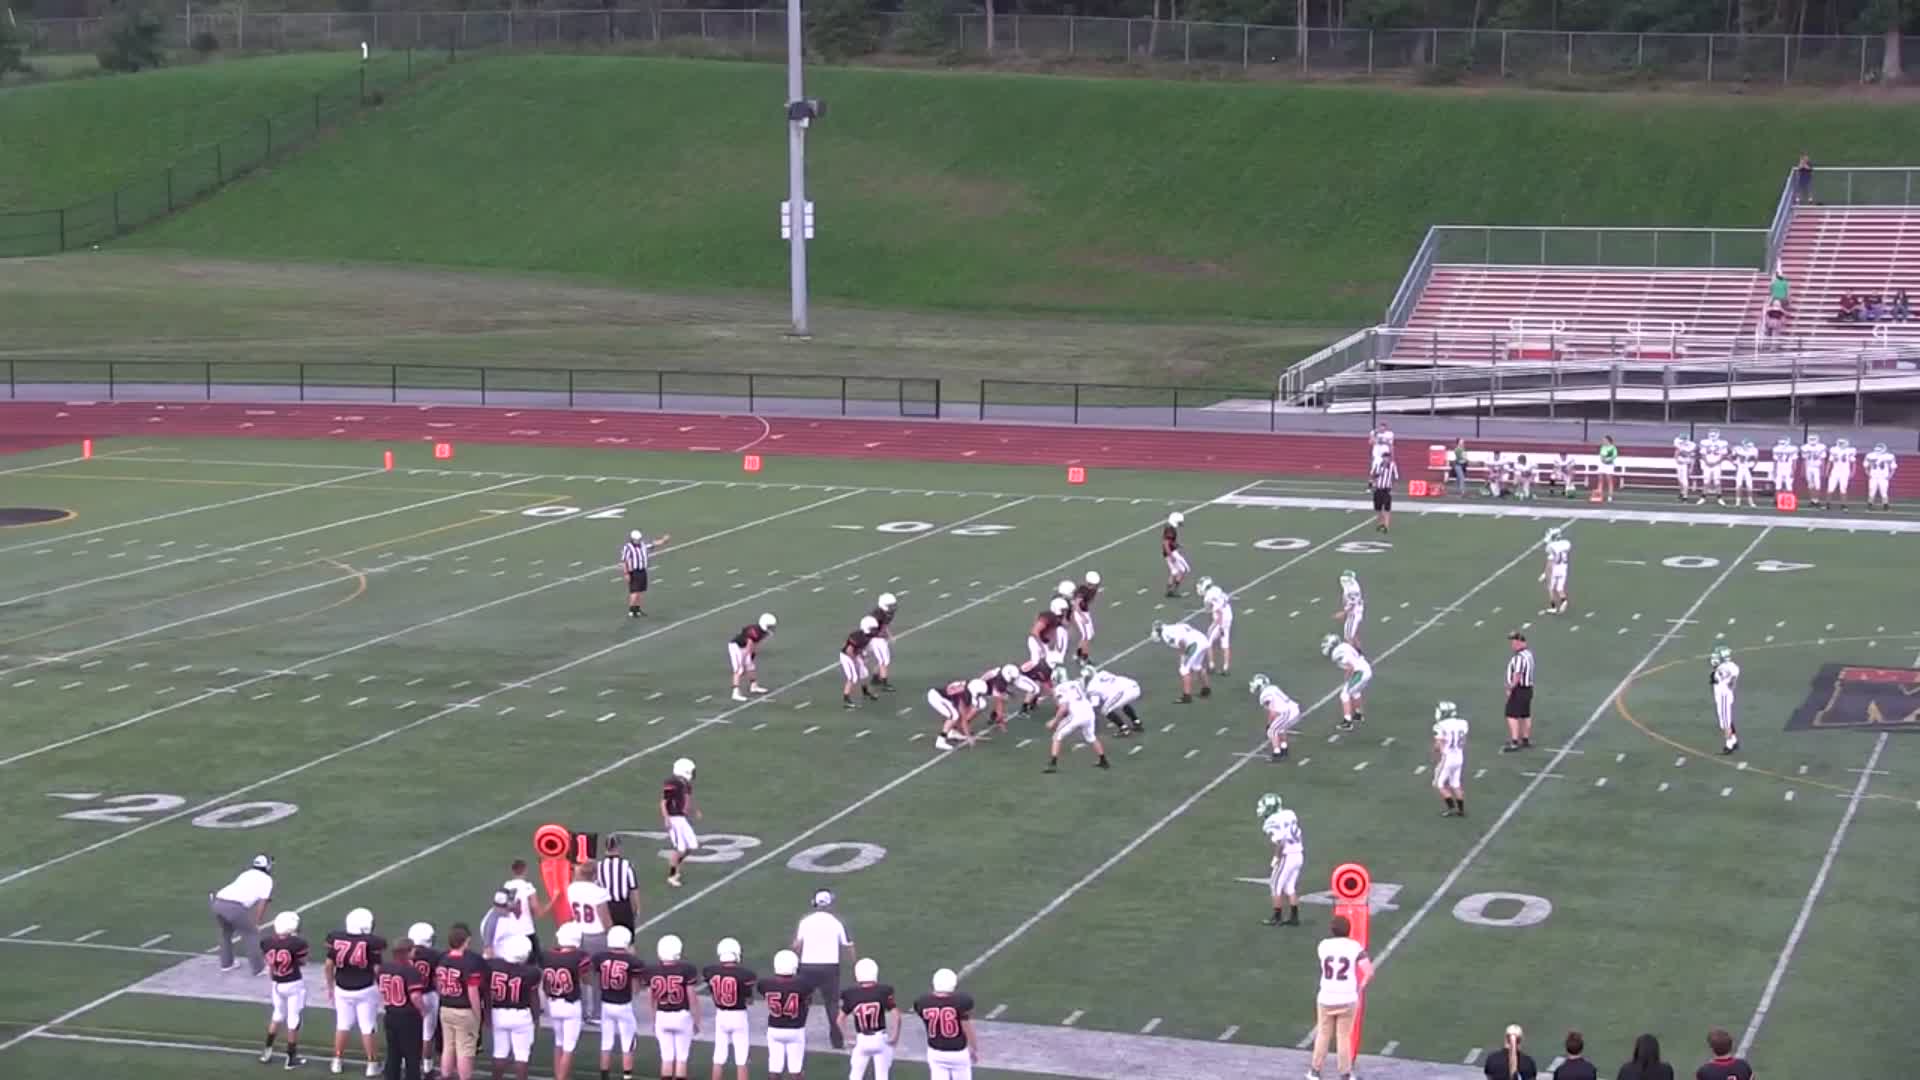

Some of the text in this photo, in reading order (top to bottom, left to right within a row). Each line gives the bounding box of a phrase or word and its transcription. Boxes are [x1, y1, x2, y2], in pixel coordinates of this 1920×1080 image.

[56, 793, 299, 829] 20
[576, 834, 589, 863] 1
[333, 939, 369, 969] 74
[1323, 956, 1351, 981] 62
[491, 971, 523, 1004] 51
[599, 958, 630, 991] 15
[649, 974, 684, 1006] 25
[765, 991, 800, 1019] 54
[854, 1001, 881, 1029] 17
[922, 1006, 960, 1039] 76
